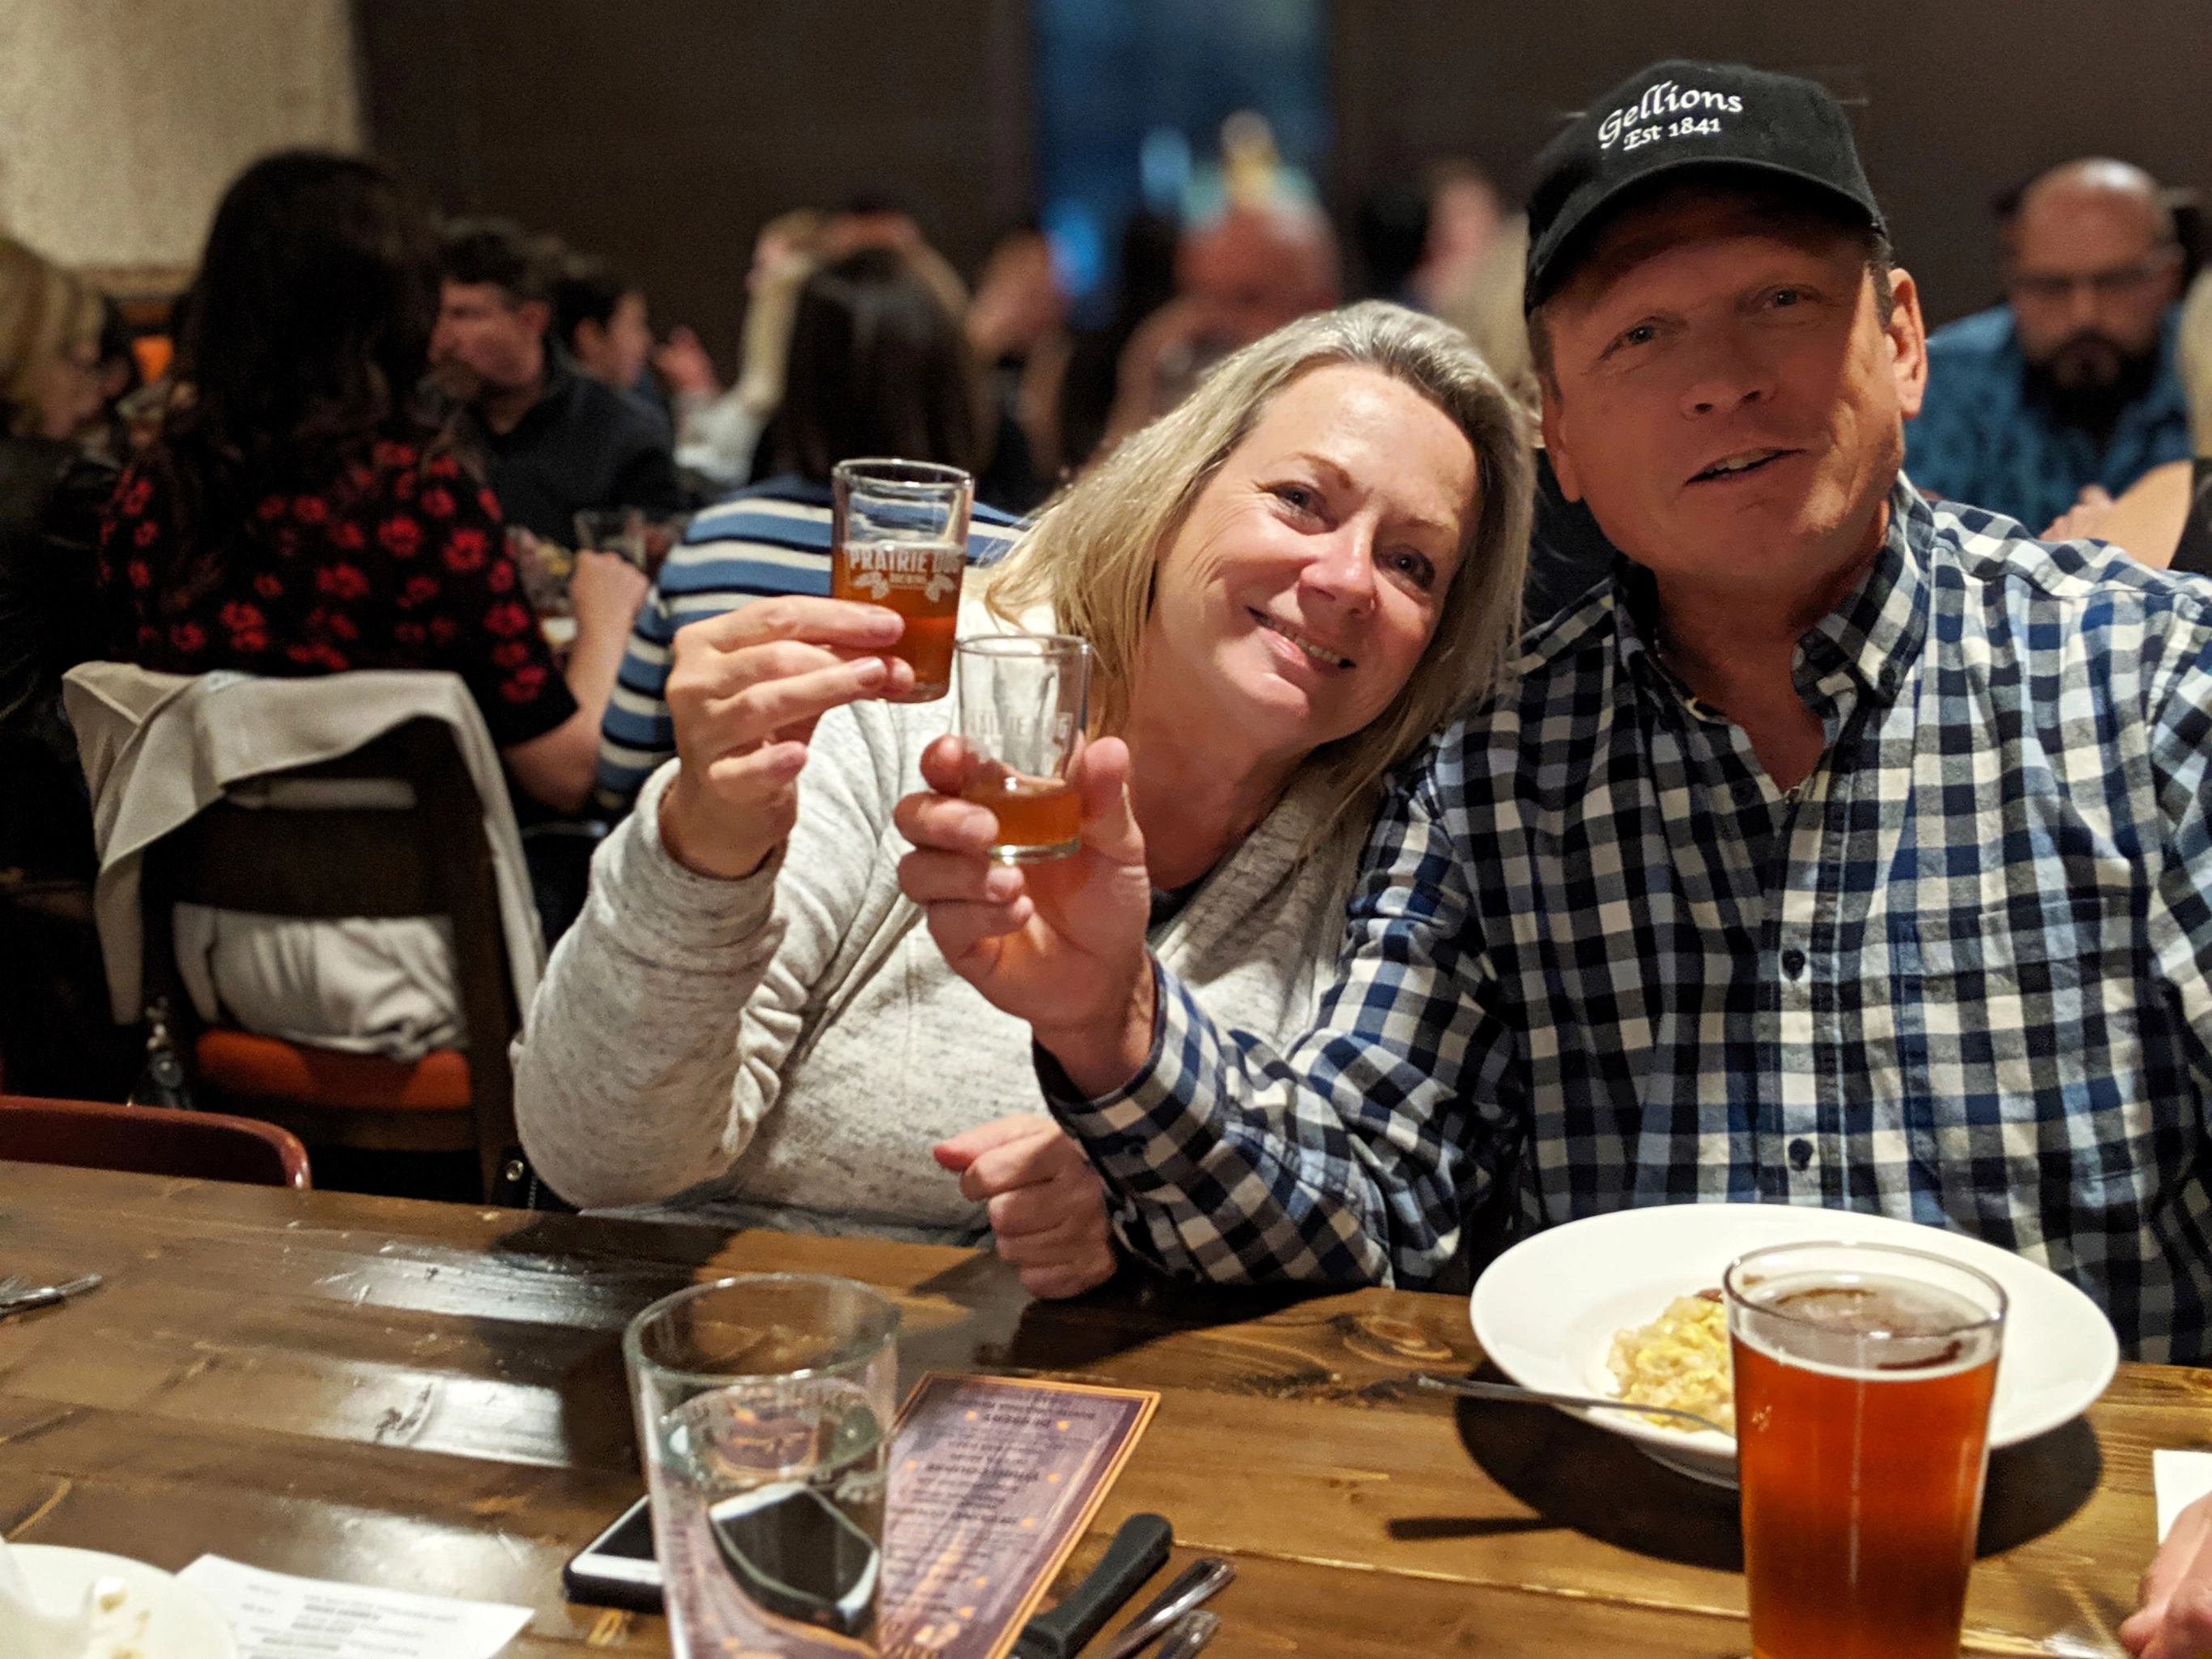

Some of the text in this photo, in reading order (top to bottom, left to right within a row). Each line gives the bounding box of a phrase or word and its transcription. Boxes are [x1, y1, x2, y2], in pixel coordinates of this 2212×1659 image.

[1598, 80, 1742, 149] Gellions
[1623, 117, 1721, 151] Est 1841
[849, 547, 928, 572] PRAIRIE
